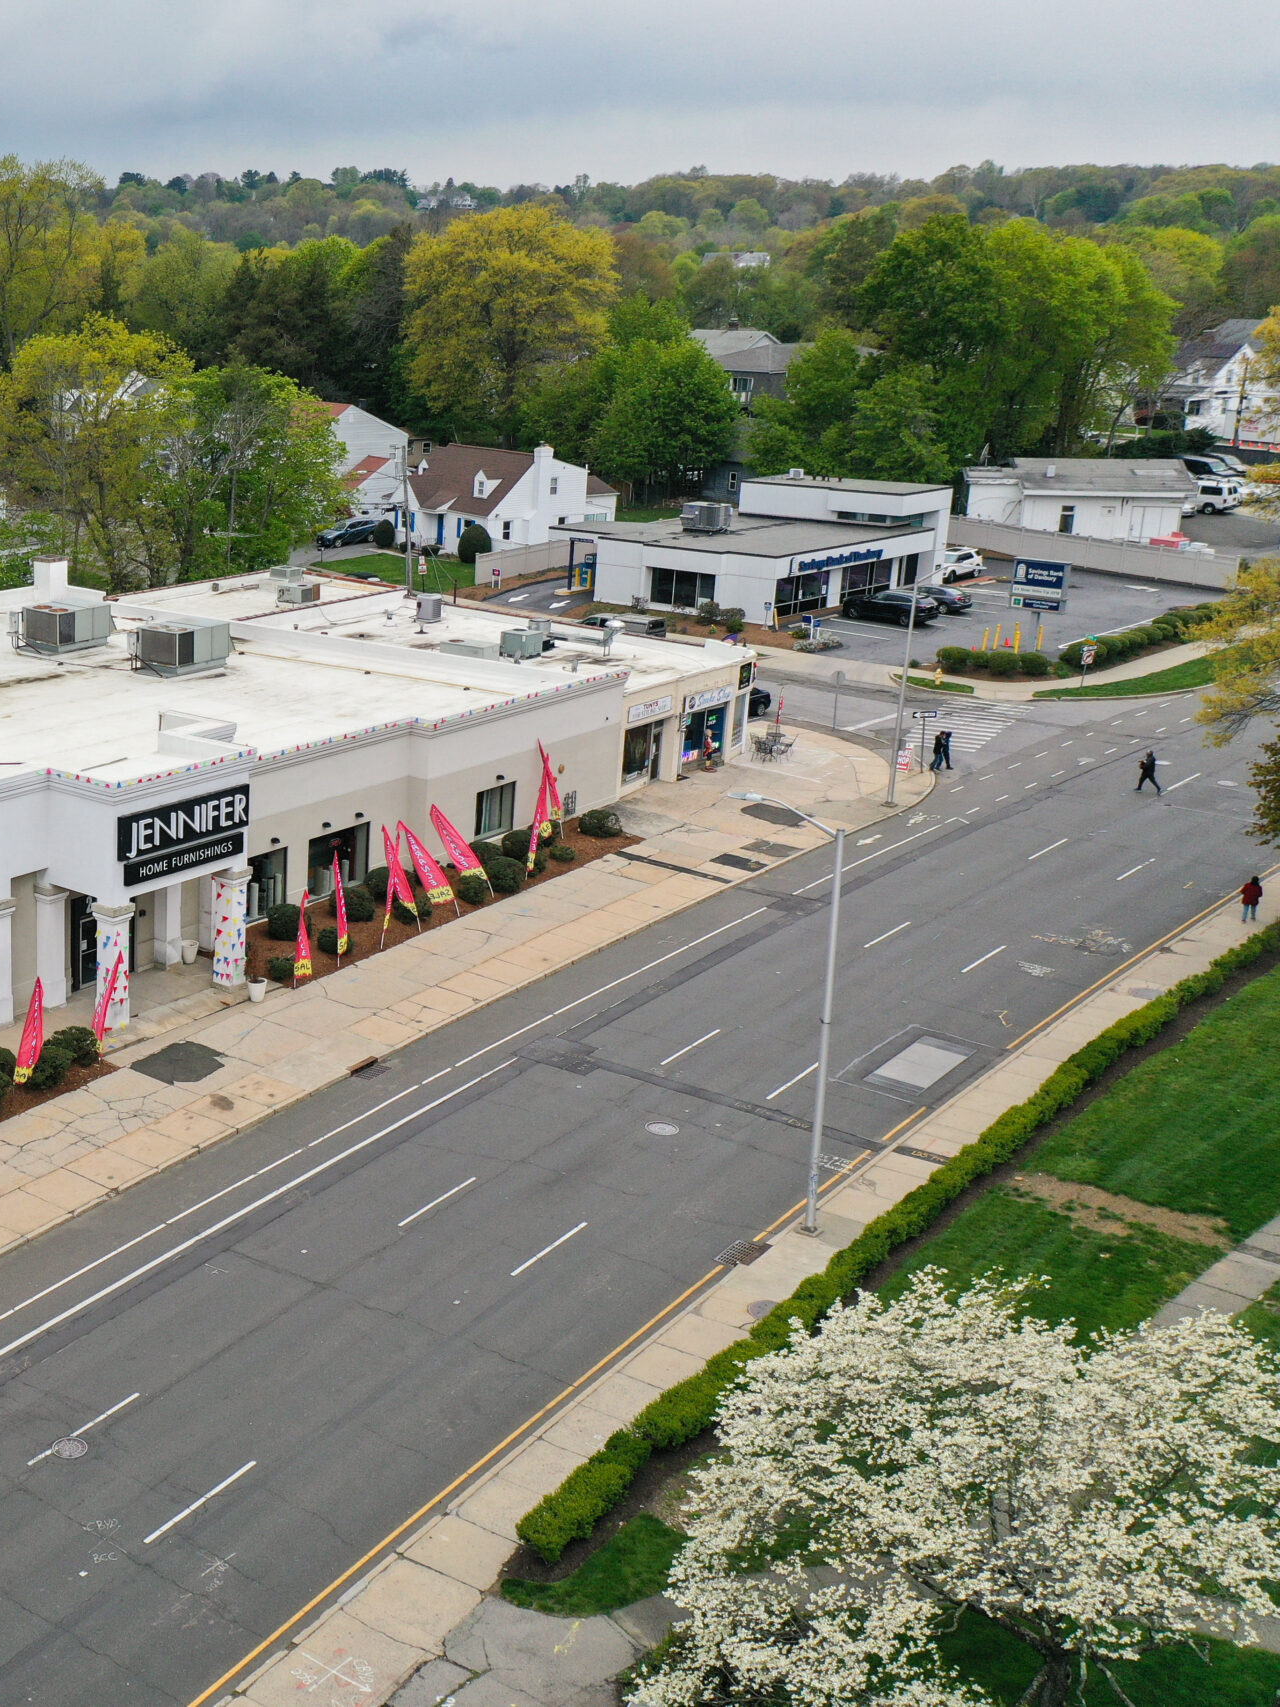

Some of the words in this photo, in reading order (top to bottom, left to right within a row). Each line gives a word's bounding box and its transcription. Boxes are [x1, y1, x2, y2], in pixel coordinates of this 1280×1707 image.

[1028, 568, 1048, 576] Savings
[1034, 574, 1057, 583] Danbury
[126, 794, 248, 859] JENNIFER
[139, 860, 169, 878] HOME
[172, 841, 233, 868] FURNISHINGS
[294, 962, 310, 972] SAL
